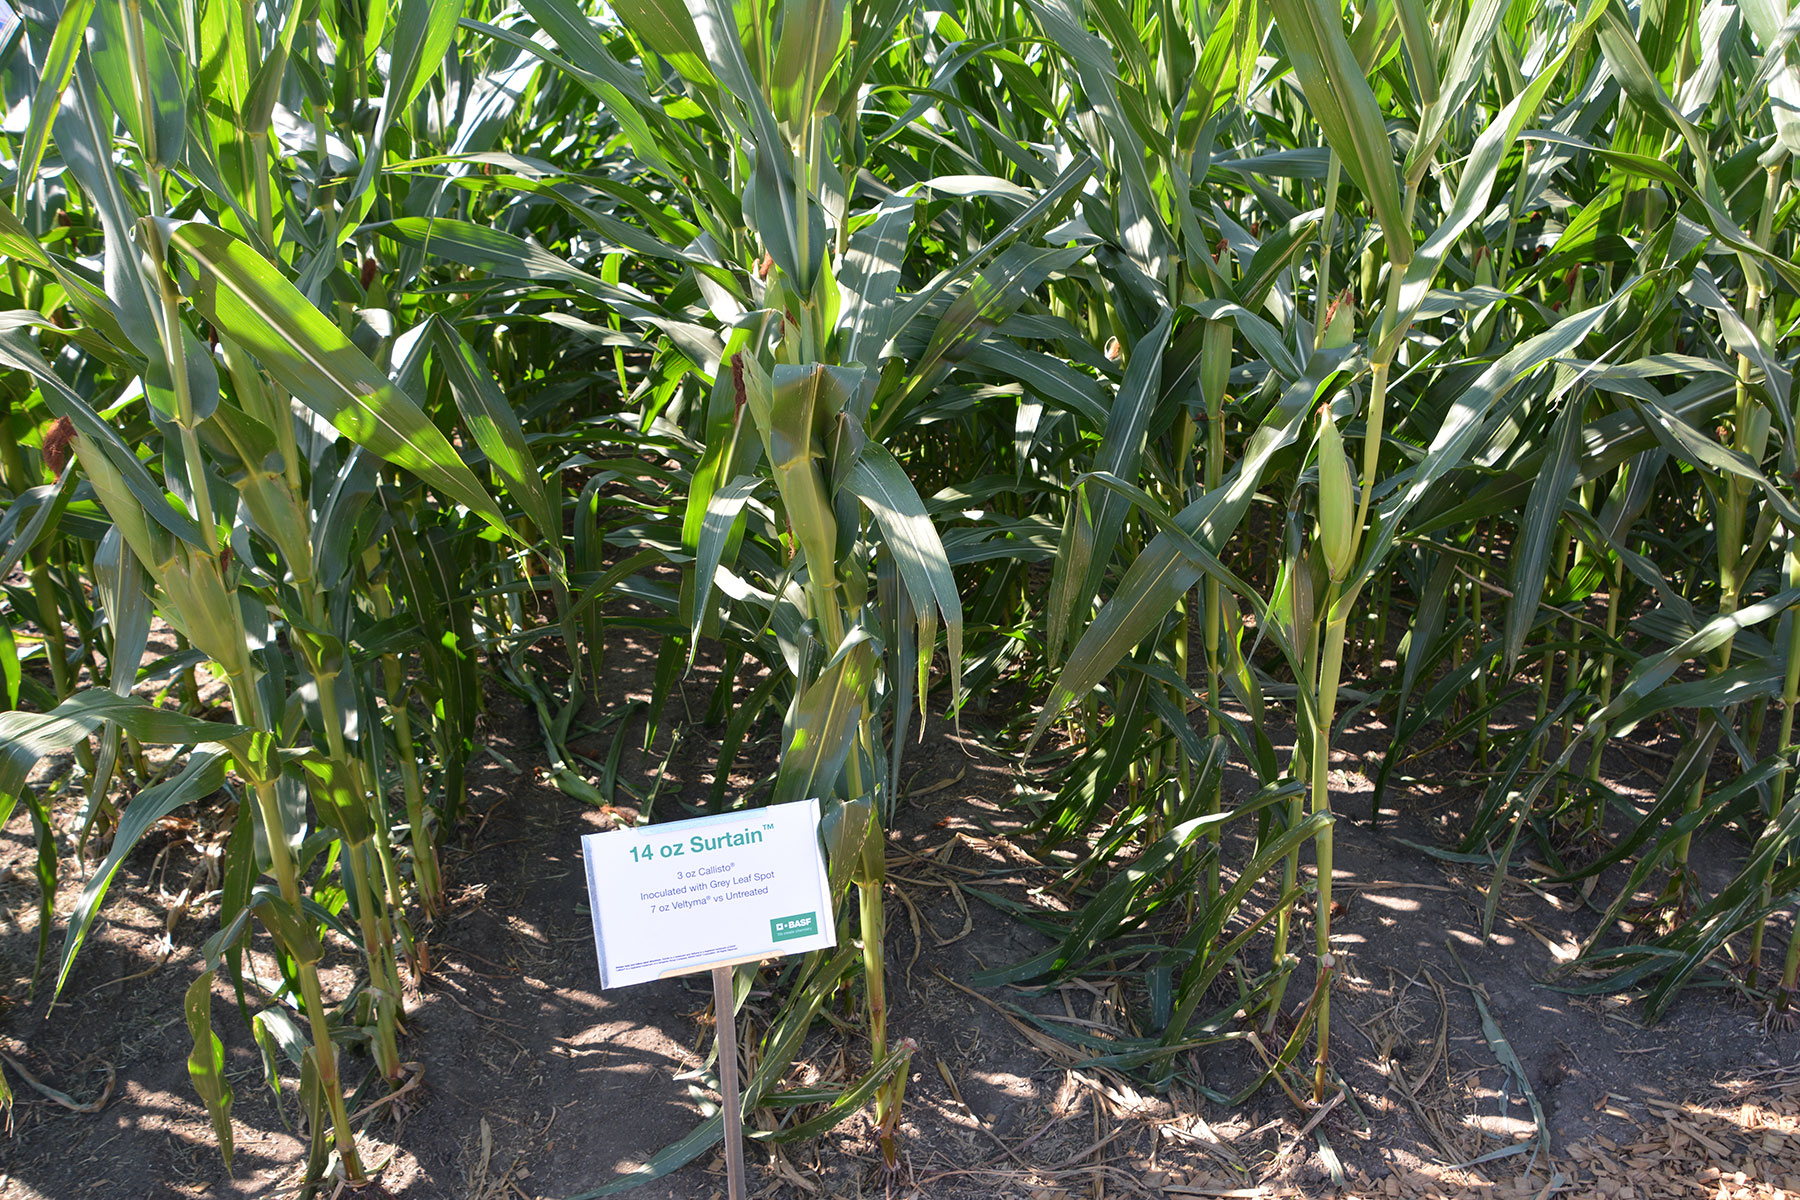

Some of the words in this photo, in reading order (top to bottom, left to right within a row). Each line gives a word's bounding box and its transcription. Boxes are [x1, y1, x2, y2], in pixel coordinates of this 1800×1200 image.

[629, 844, 654, 863] 14
[660, 842, 685, 858] oz
[640, 885, 687, 900] Inoculated
[689, 882, 708, 892] with
[709, 879, 731, 889] Grey
[732, 874, 752, 885] Leaf
[753, 871, 775, 881] Spot
[676, 871, 684, 880] 3
[685, 870, 697, 879] oz
[650, 905, 656, 913] 7
[658, 904, 670, 912] oz
[713, 894, 724, 902] vs
[725, 886, 769, 900] Untreated
[788, 917, 812, 929] BASF
